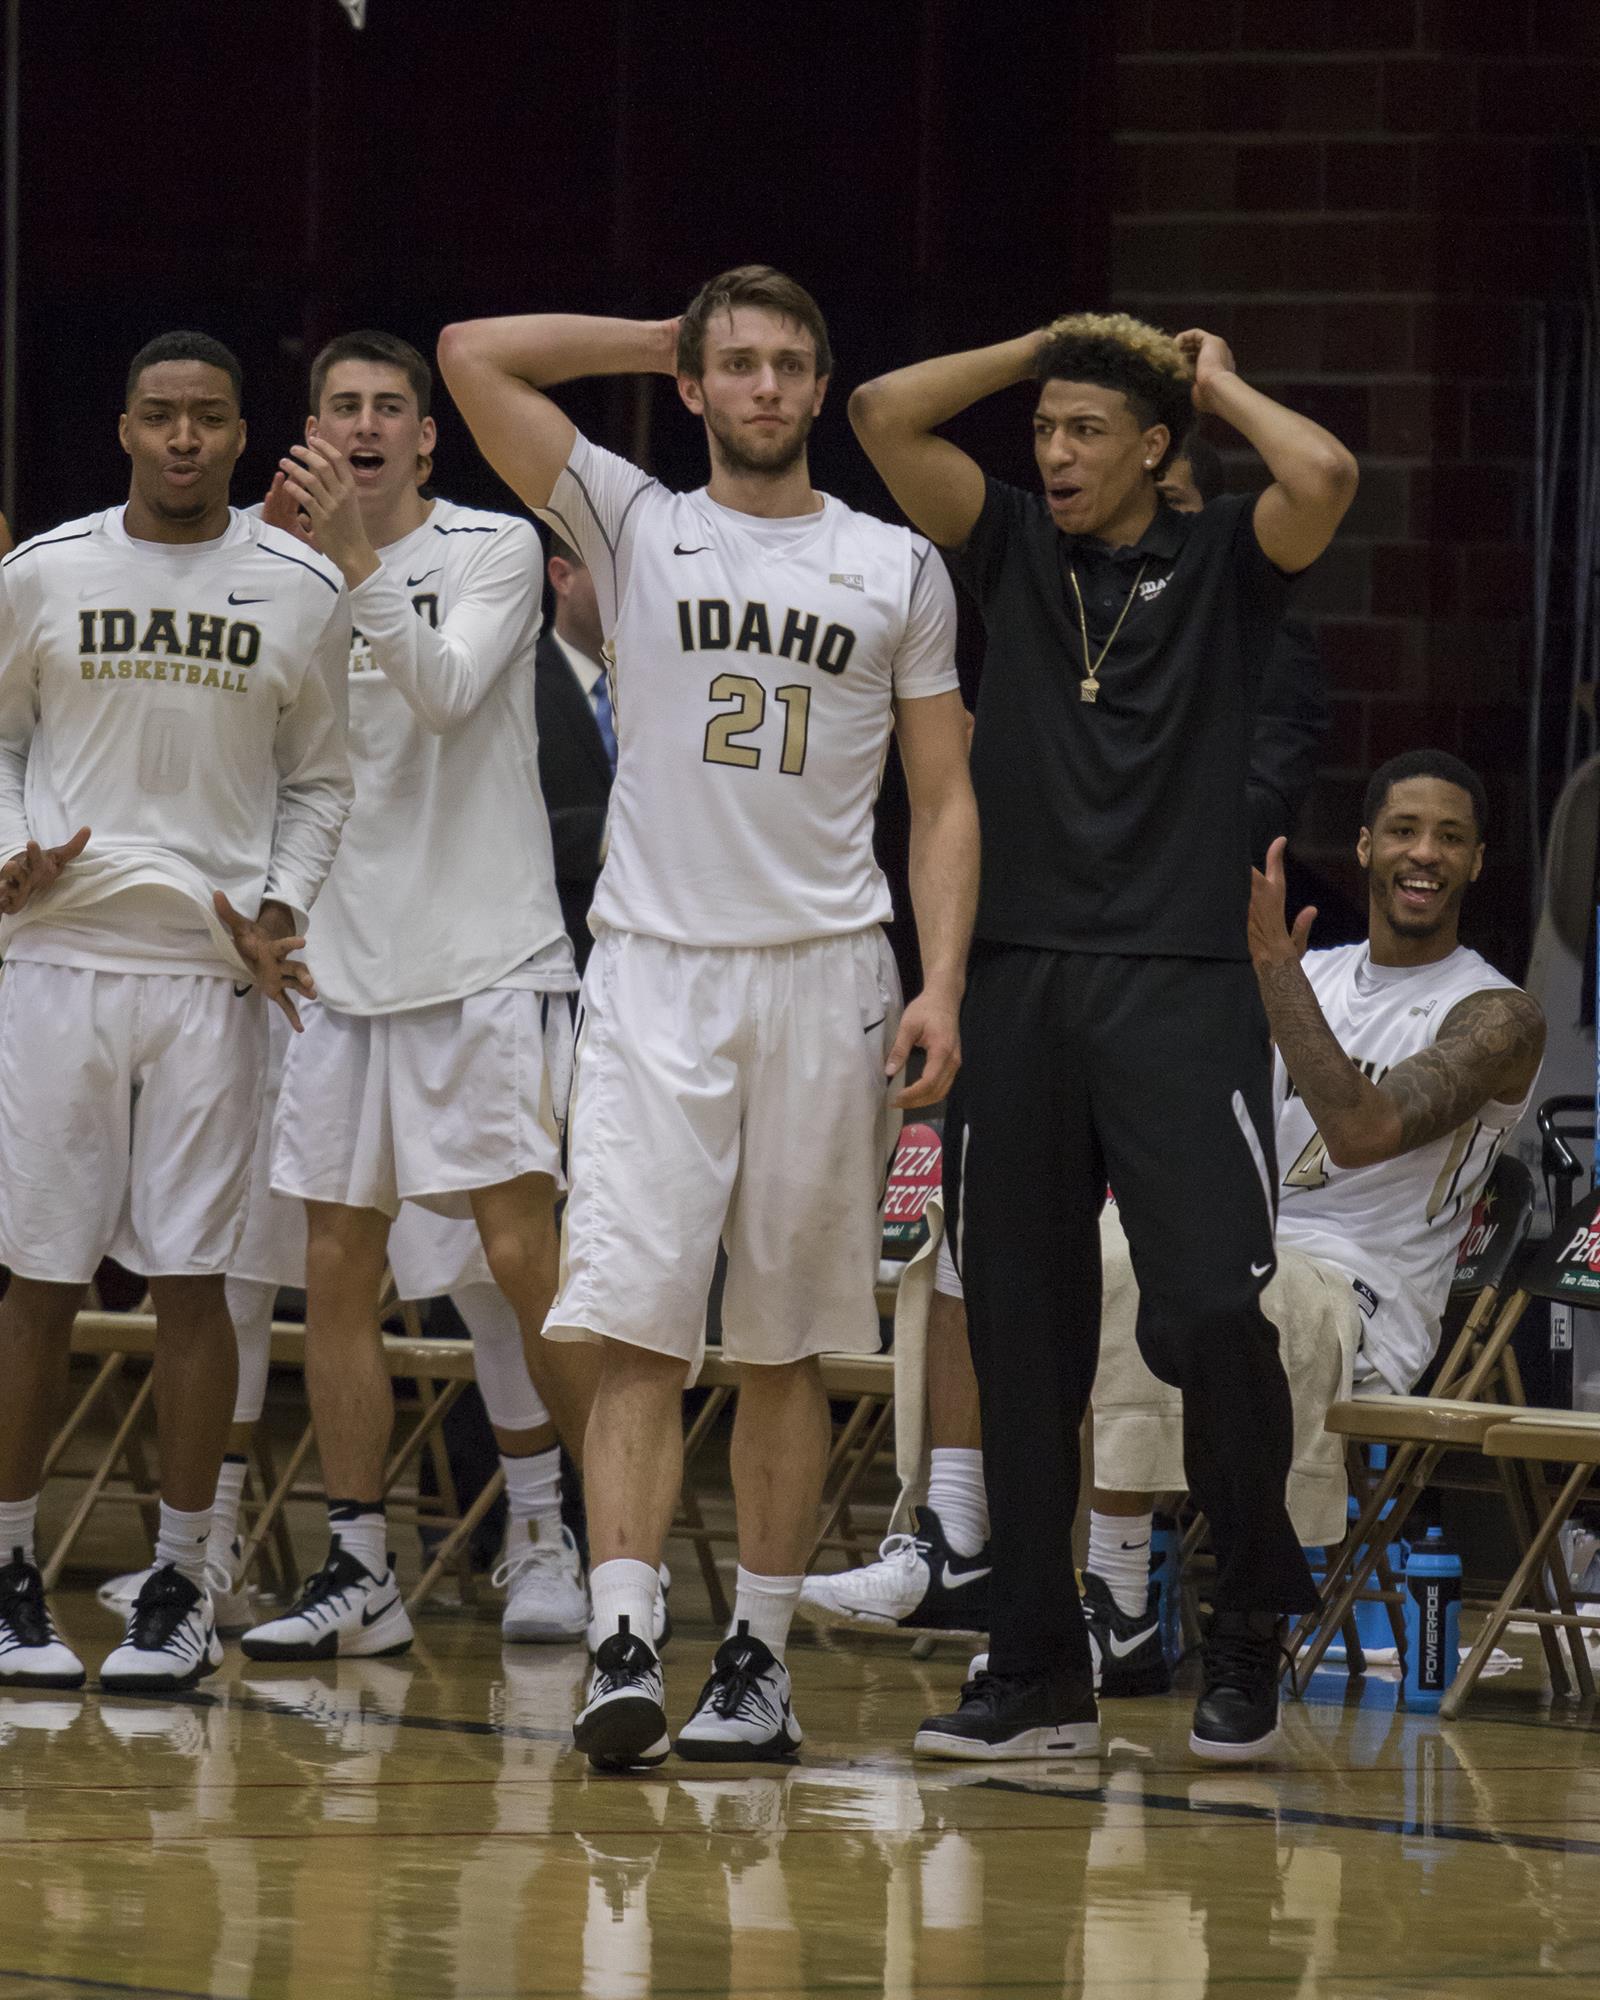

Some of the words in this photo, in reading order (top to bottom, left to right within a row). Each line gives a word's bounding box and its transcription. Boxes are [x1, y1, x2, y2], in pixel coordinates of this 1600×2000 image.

[78, 608, 261, 668] IDAHO
[677, 599, 857, 676] IDAHO
[80, 660, 249, 693] BASKETBALL
[703, 672, 812, 776] 21
[1425, 1585, 1439, 1683] POWERADE
